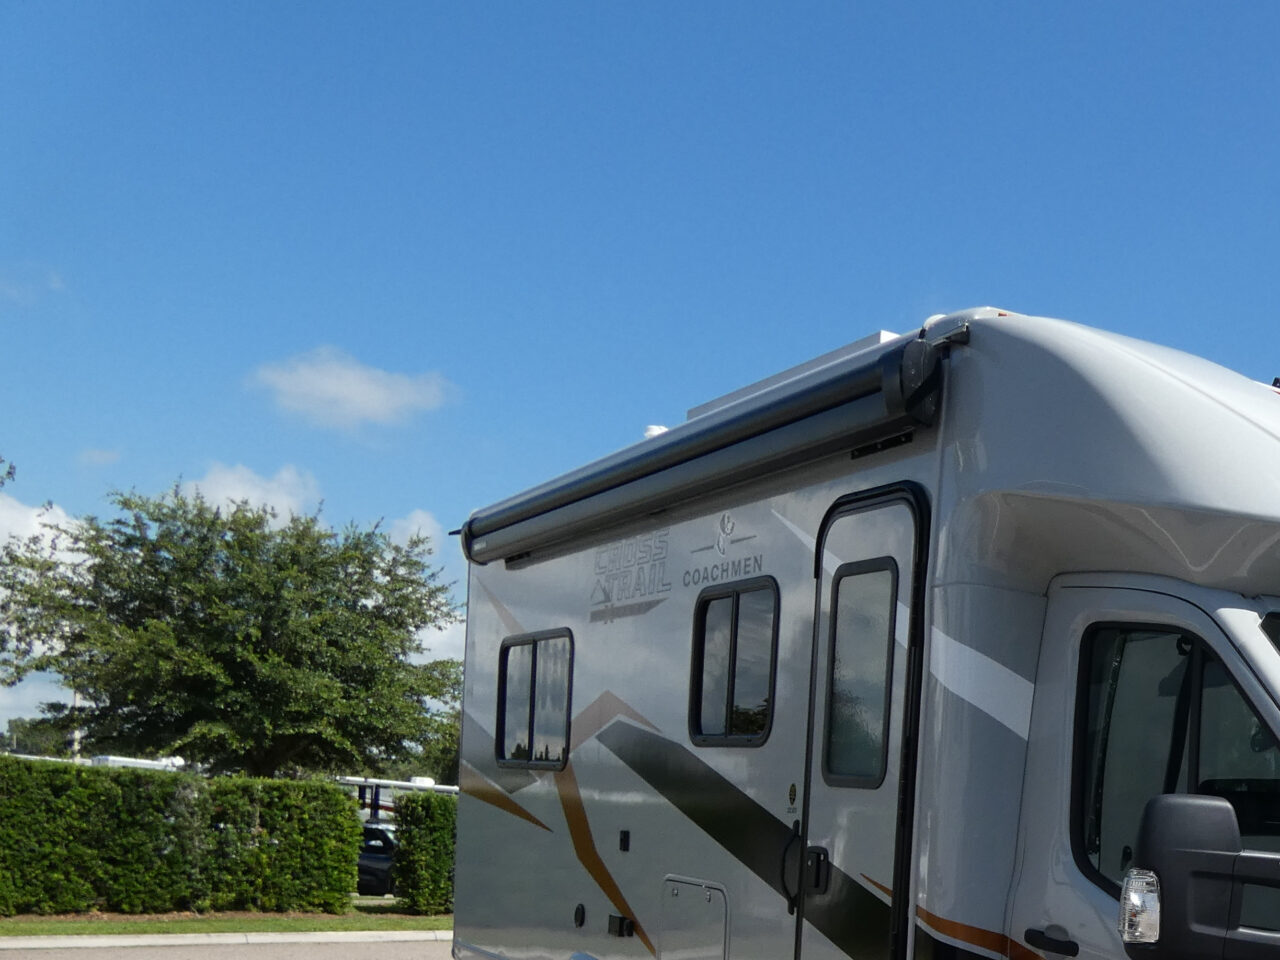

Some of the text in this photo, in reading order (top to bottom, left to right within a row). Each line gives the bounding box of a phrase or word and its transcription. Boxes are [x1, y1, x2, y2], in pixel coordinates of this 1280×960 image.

[595, 528, 670, 575] CROSS
[683, 554, 763, 587] COACHMEN
[605, 561, 671, 600] TRAIL
